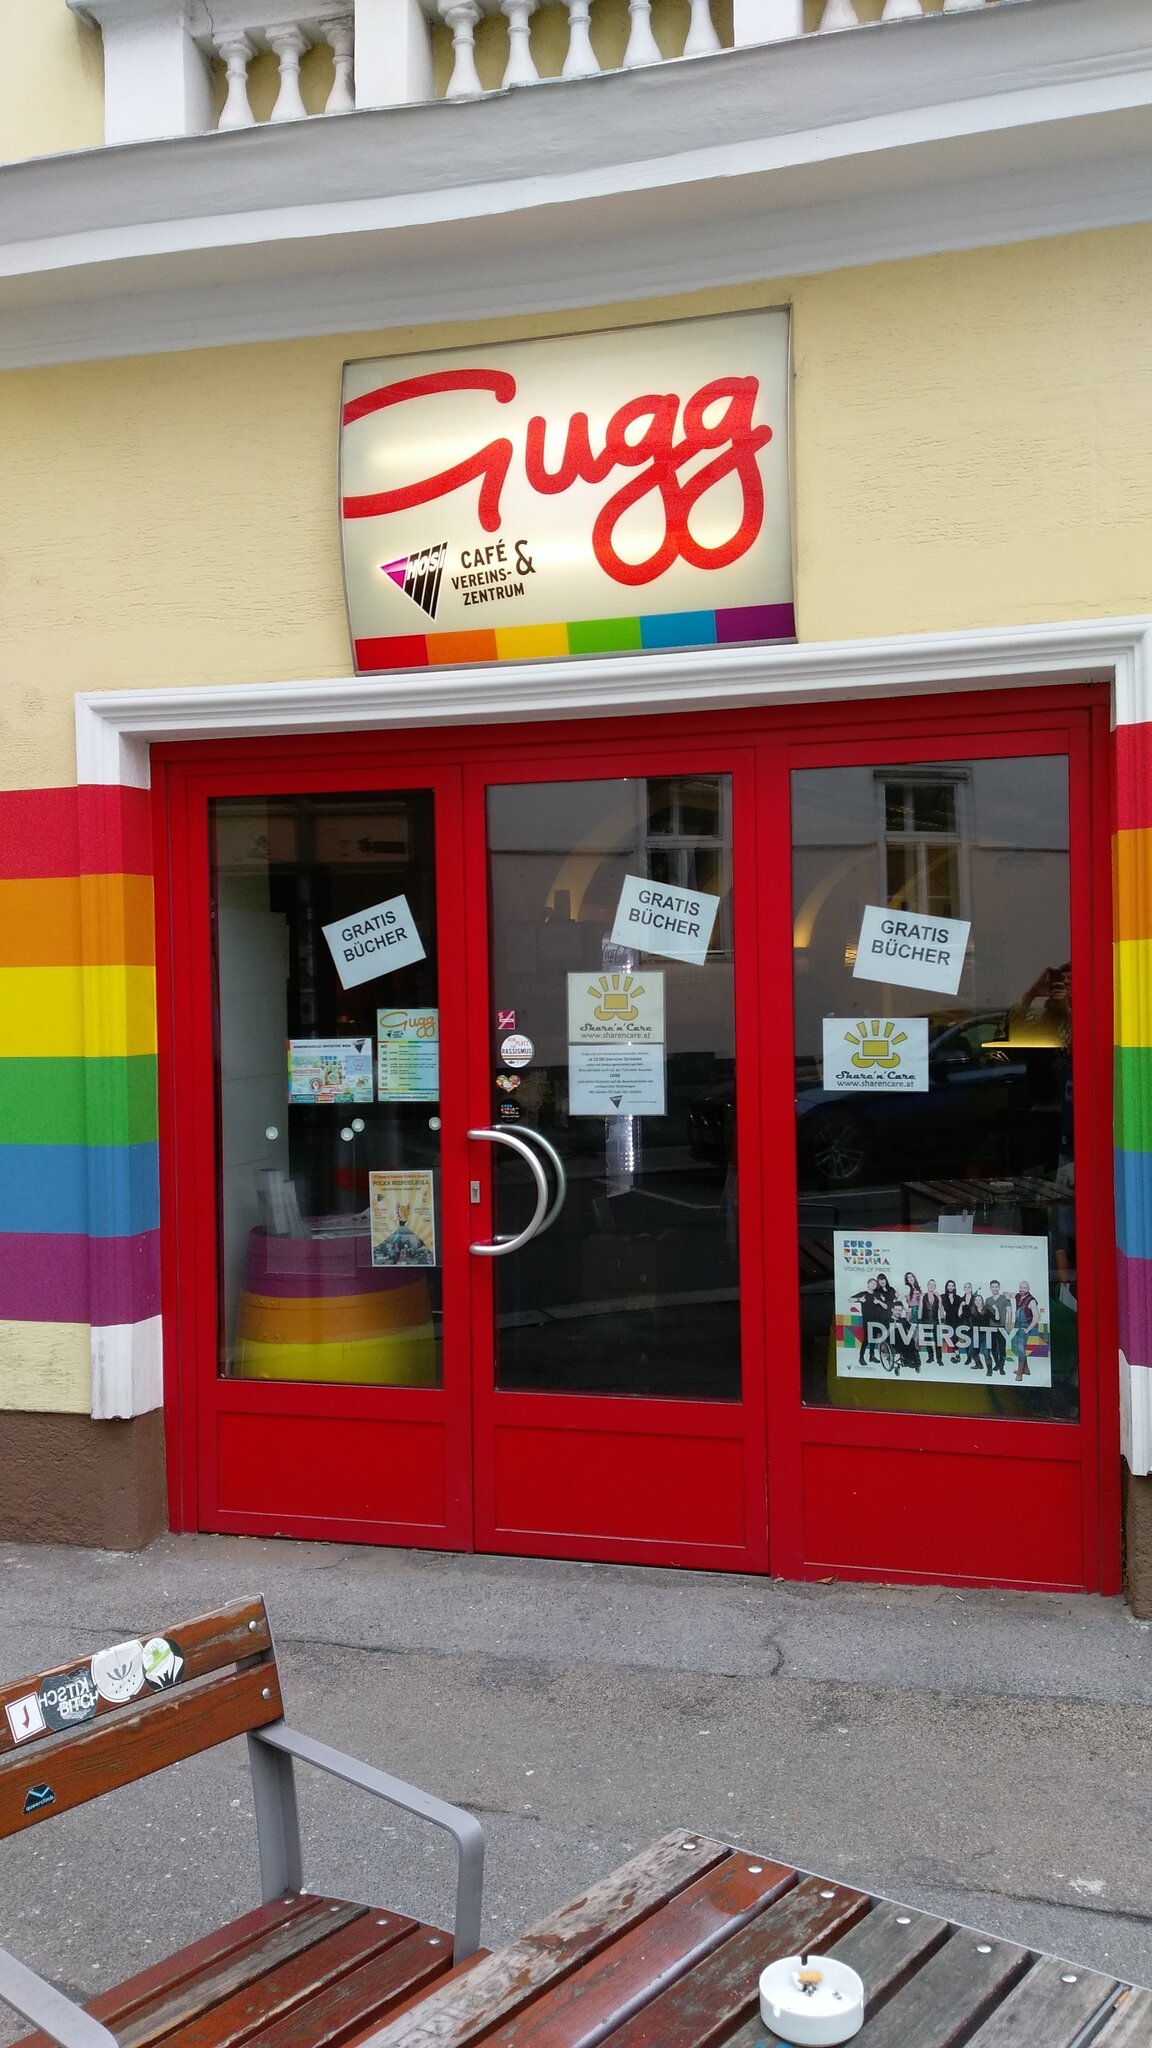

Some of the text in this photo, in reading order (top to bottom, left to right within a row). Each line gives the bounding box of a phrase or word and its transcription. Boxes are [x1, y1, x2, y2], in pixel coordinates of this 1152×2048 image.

[343, 369, 773, 586] Gugg
[406, 548, 447, 581] HOSI
[460, 539, 537, 576] CAFÉ &
[451, 568, 512, 590] VEREINS-
[462, 582, 525, 606] ZENTRUM
[638, 890, 701, 916] GRATIS
[342, 911, 396, 942] GRATIS
[628, 908, 701, 938] BÜCHER
[881, 919, 950, 944] GRATIS
[343, 927, 408, 962] BÜCHER
[871, 939, 951, 966] BÜCHER
[379, 1010, 436, 1039] Gugg
[837, 1080, 915, 1088] www.sharencare.at
[843, 1240, 873, 1248] EURO
[843, 1248, 880, 1257] PRIDE
[843, 1256, 891, 1265] VIENNA
[867, 1321, 1020, 1349] DIVERSITY
